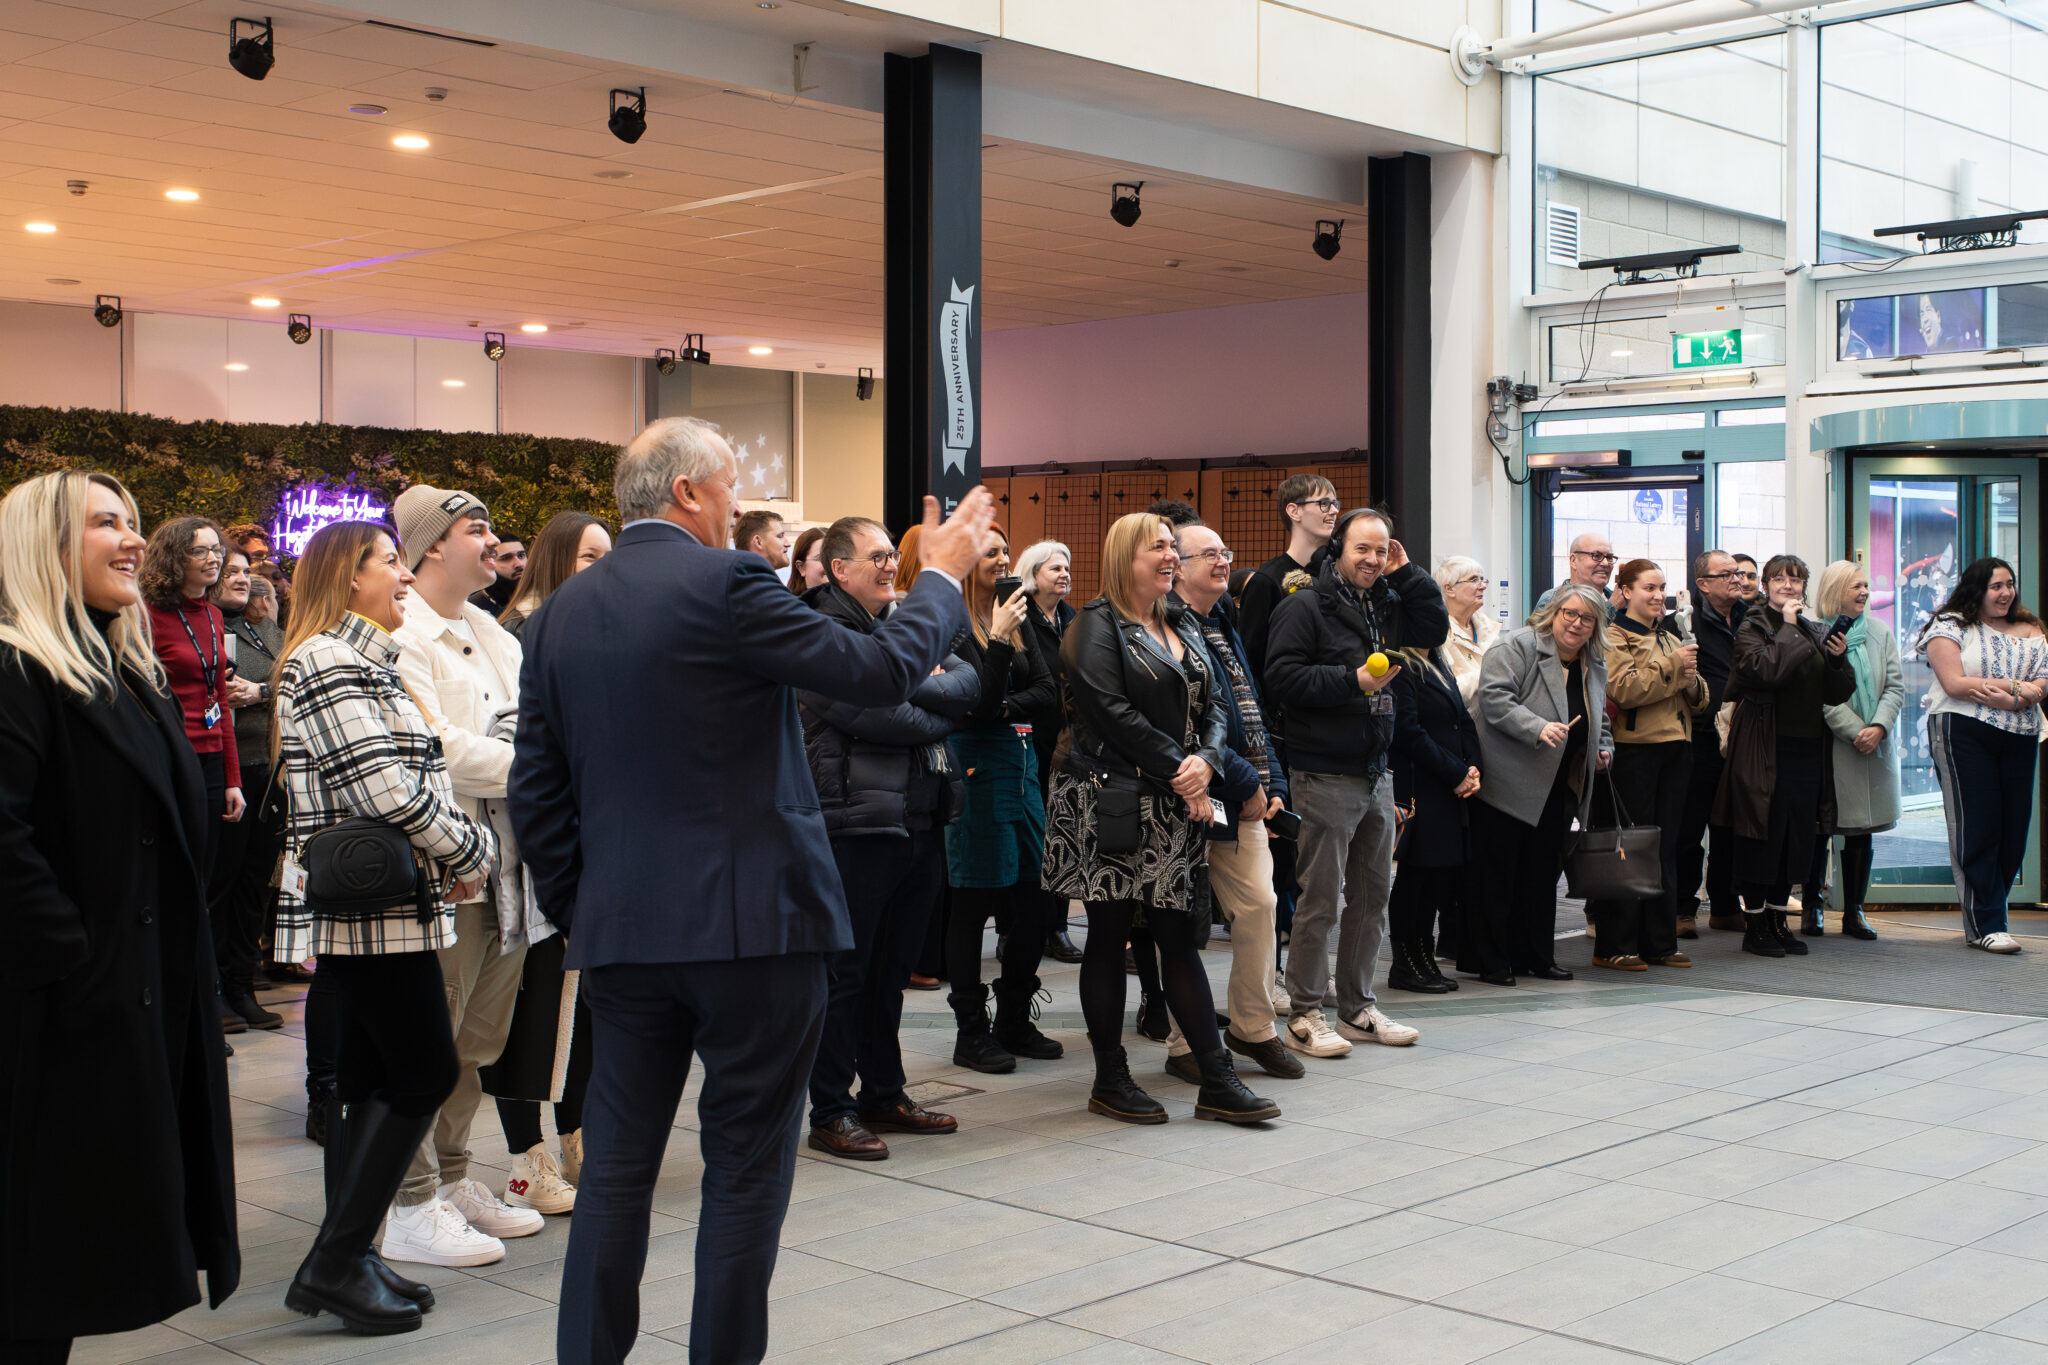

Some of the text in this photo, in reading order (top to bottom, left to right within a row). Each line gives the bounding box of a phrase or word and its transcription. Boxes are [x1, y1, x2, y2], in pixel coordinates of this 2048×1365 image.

[951, 310, 965, 441] 25TH ANNIVERSARY
[286, 489, 386, 521] Welcome to Your
